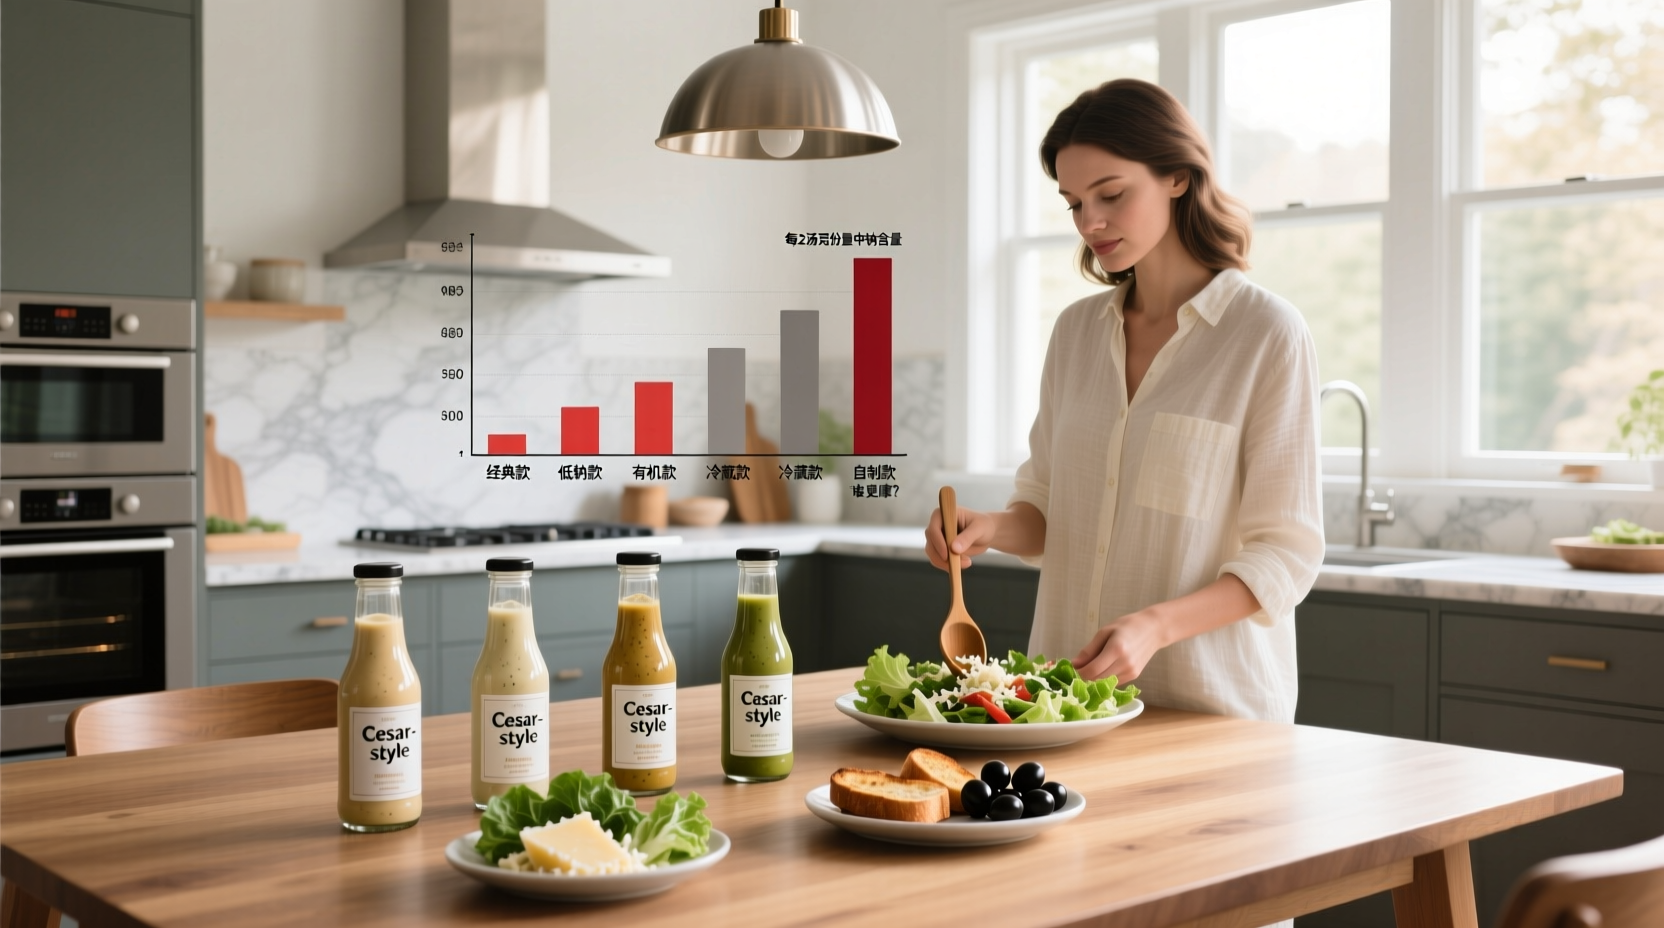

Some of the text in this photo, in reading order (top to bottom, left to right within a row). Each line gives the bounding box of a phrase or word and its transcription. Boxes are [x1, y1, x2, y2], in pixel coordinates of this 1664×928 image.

[624, 701, 672, 716] Cesar-
[745, 707, 781, 727] style
[492, 711, 543, 728] Cesar-
[630, 717, 666, 737] style
[362, 725, 416, 742] Cesar-
[499, 728, 538, 749] style
[370, 742, 410, 764] style
